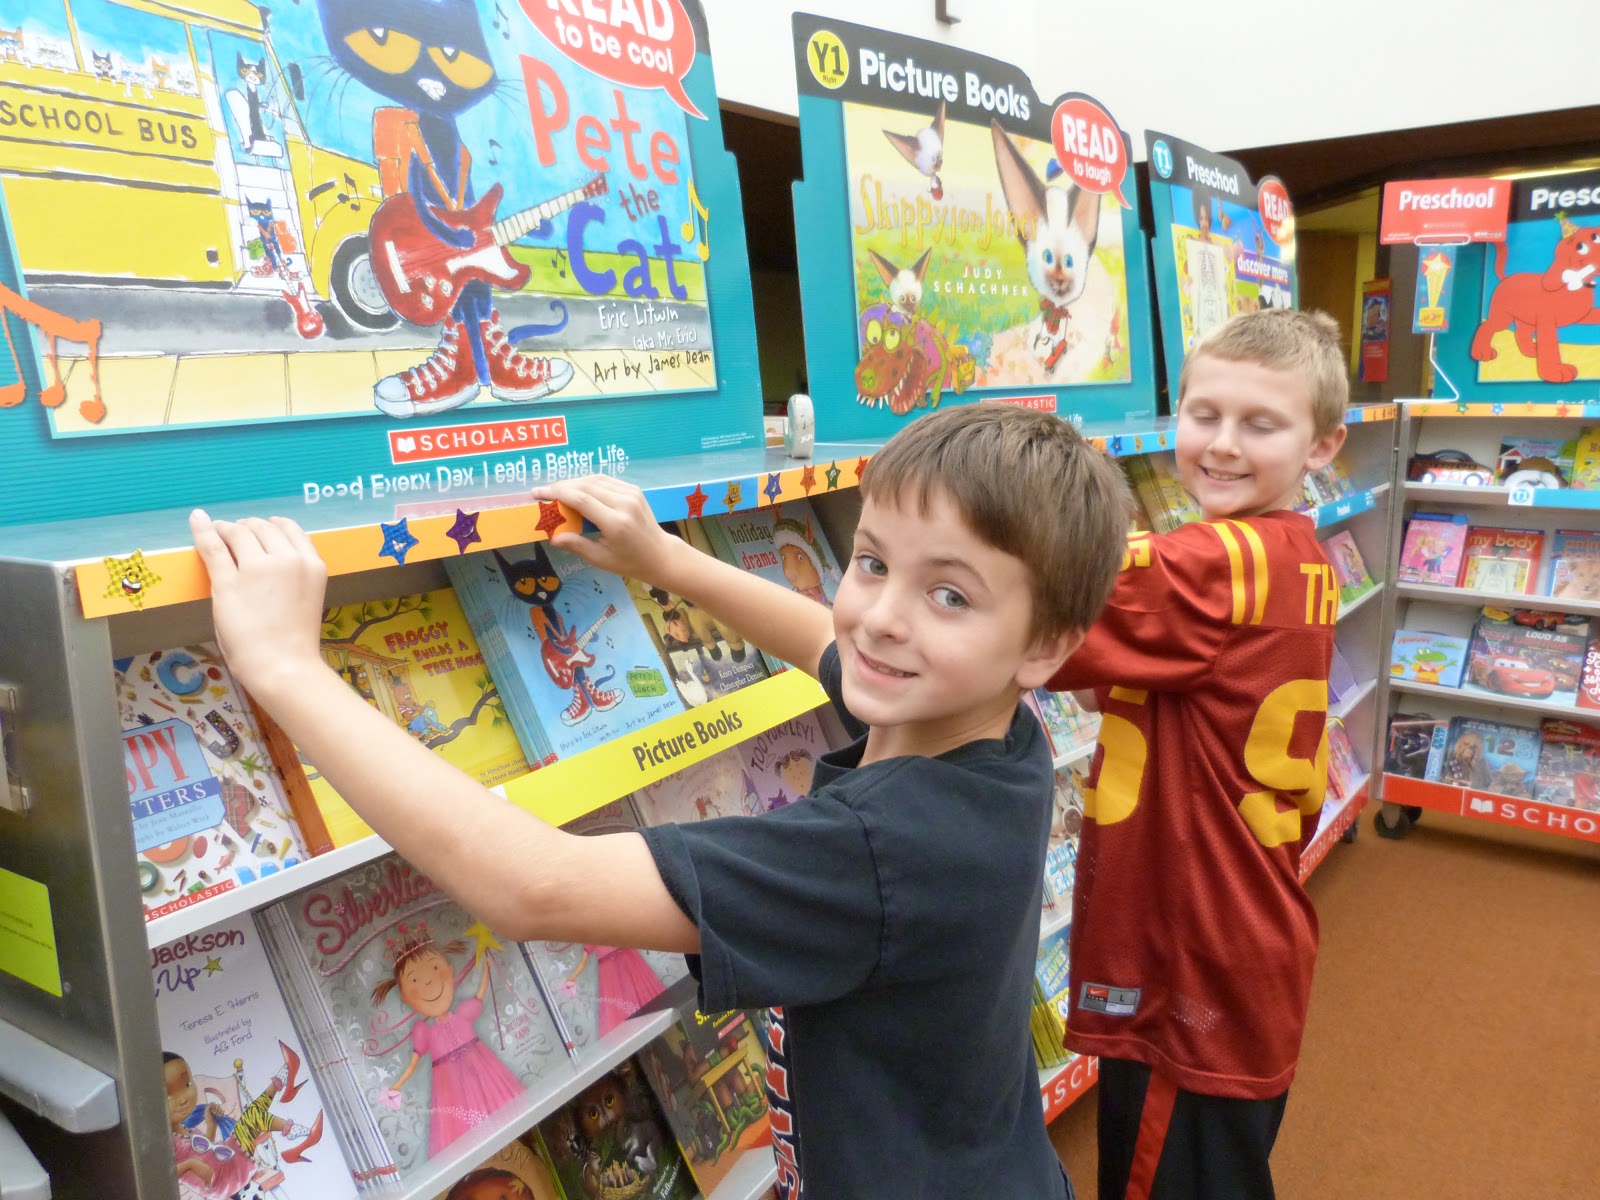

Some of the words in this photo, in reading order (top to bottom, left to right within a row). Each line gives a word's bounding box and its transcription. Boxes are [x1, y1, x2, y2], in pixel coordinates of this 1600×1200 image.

[554, 17, 583, 48] to
[588, 26, 621, 59] be
[628, 40, 674, 75] cool
[811, 39, 845, 77] Y1
[858, 48, 959, 103] Picture
[964, 71, 1031, 121] Books
[0, 102, 124, 136] SCHOOL
[138, 117, 198, 149] BUS
[518, 53, 680, 185] Pete
[1061, 113, 1119, 165] READ
[1073, 159, 1084, 175] to
[1085, 164, 1112, 185] laugh
[1186, 156, 1240, 196] Preschool
[618, 183, 660, 222] the
[1262, 191, 1290, 221] READ
[1399, 187, 1495, 211] Preschool
[567, 200, 688, 300] Cat
[962, 267, 1003, 280] JUDY
[1237, 255, 1271, 277] discover
[1271, 263, 1289, 281] more
[933, 281, 1028, 297] SCHACHNER
[598, 302, 629, 330] Eric
[633, 298, 679, 326] Litwin
[594, 361, 618, 383] Art
[623, 359, 641, 379] by
[648, 354, 681, 374] James
[686, 350, 710, 364] Dean
[420, 422, 563, 452] SCHOLASTIC
[546, 450, 594, 471] Better
[728, 522, 774, 545] holiday
[1495, 533, 1538, 551] body
[741, 551, 779, 570] drama
[384, 621, 450, 653] FROGGY
[412, 642, 453, 662] BUILDS
[458, 638, 469, 651] A
[1525, 630, 1552, 641] LOUD
[1553, 635, 1569, 643] AS
[422, 658, 455, 677] TREE
[632, 729, 697, 771] Picture
[693, 710, 743, 745] Books
[1500, 803, 1596, 834] SCHO
[151, 880, 234, 919] SCHOLASTIC
[151, 929, 245, 969] Jackson
[180, 1013, 214, 1033] Teresa
